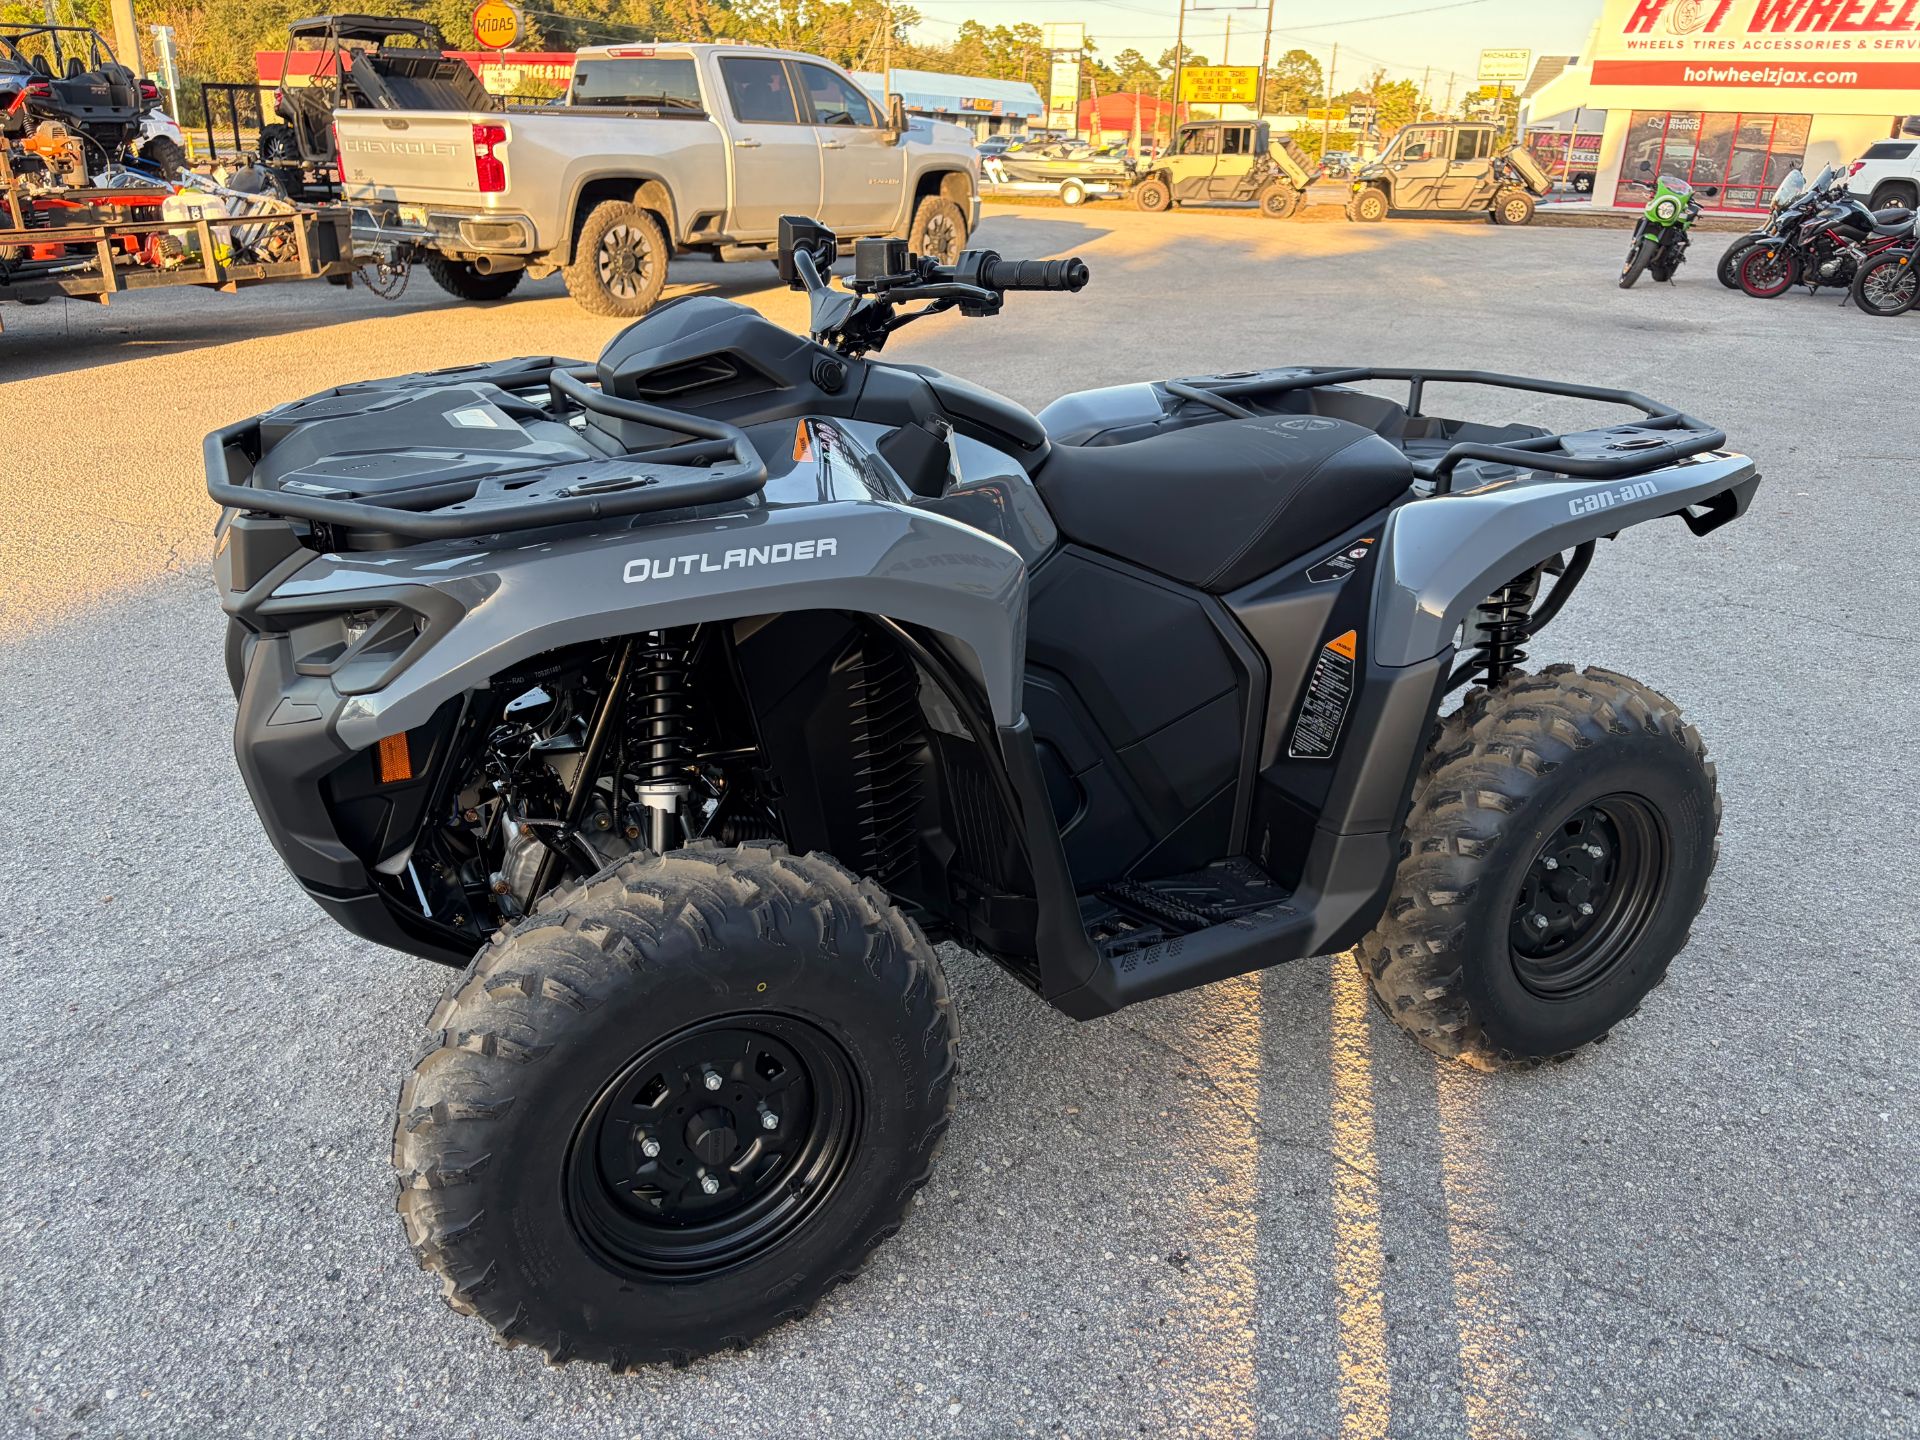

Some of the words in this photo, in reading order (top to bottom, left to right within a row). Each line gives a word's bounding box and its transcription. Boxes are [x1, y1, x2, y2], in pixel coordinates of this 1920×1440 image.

[477, 17, 514, 33] MIDAS
[1746, 0, 1920, 33] WHEEL
[1627, 40, 1684, 49] WHEELS
[1693, 40, 1736, 50] TIRES
[1743, 40, 1852, 50] ACCESSORIES
[1857, 39, 1867, 49] &
[1873, 39, 1920, 49] SERV
[1683, 66, 1858, 86] hotwheelzjax.com
[345, 140, 461, 157] CHEVROLET
[1568, 480, 1659, 516] can-am
[622, 537, 838, 584] OUTLANDER
